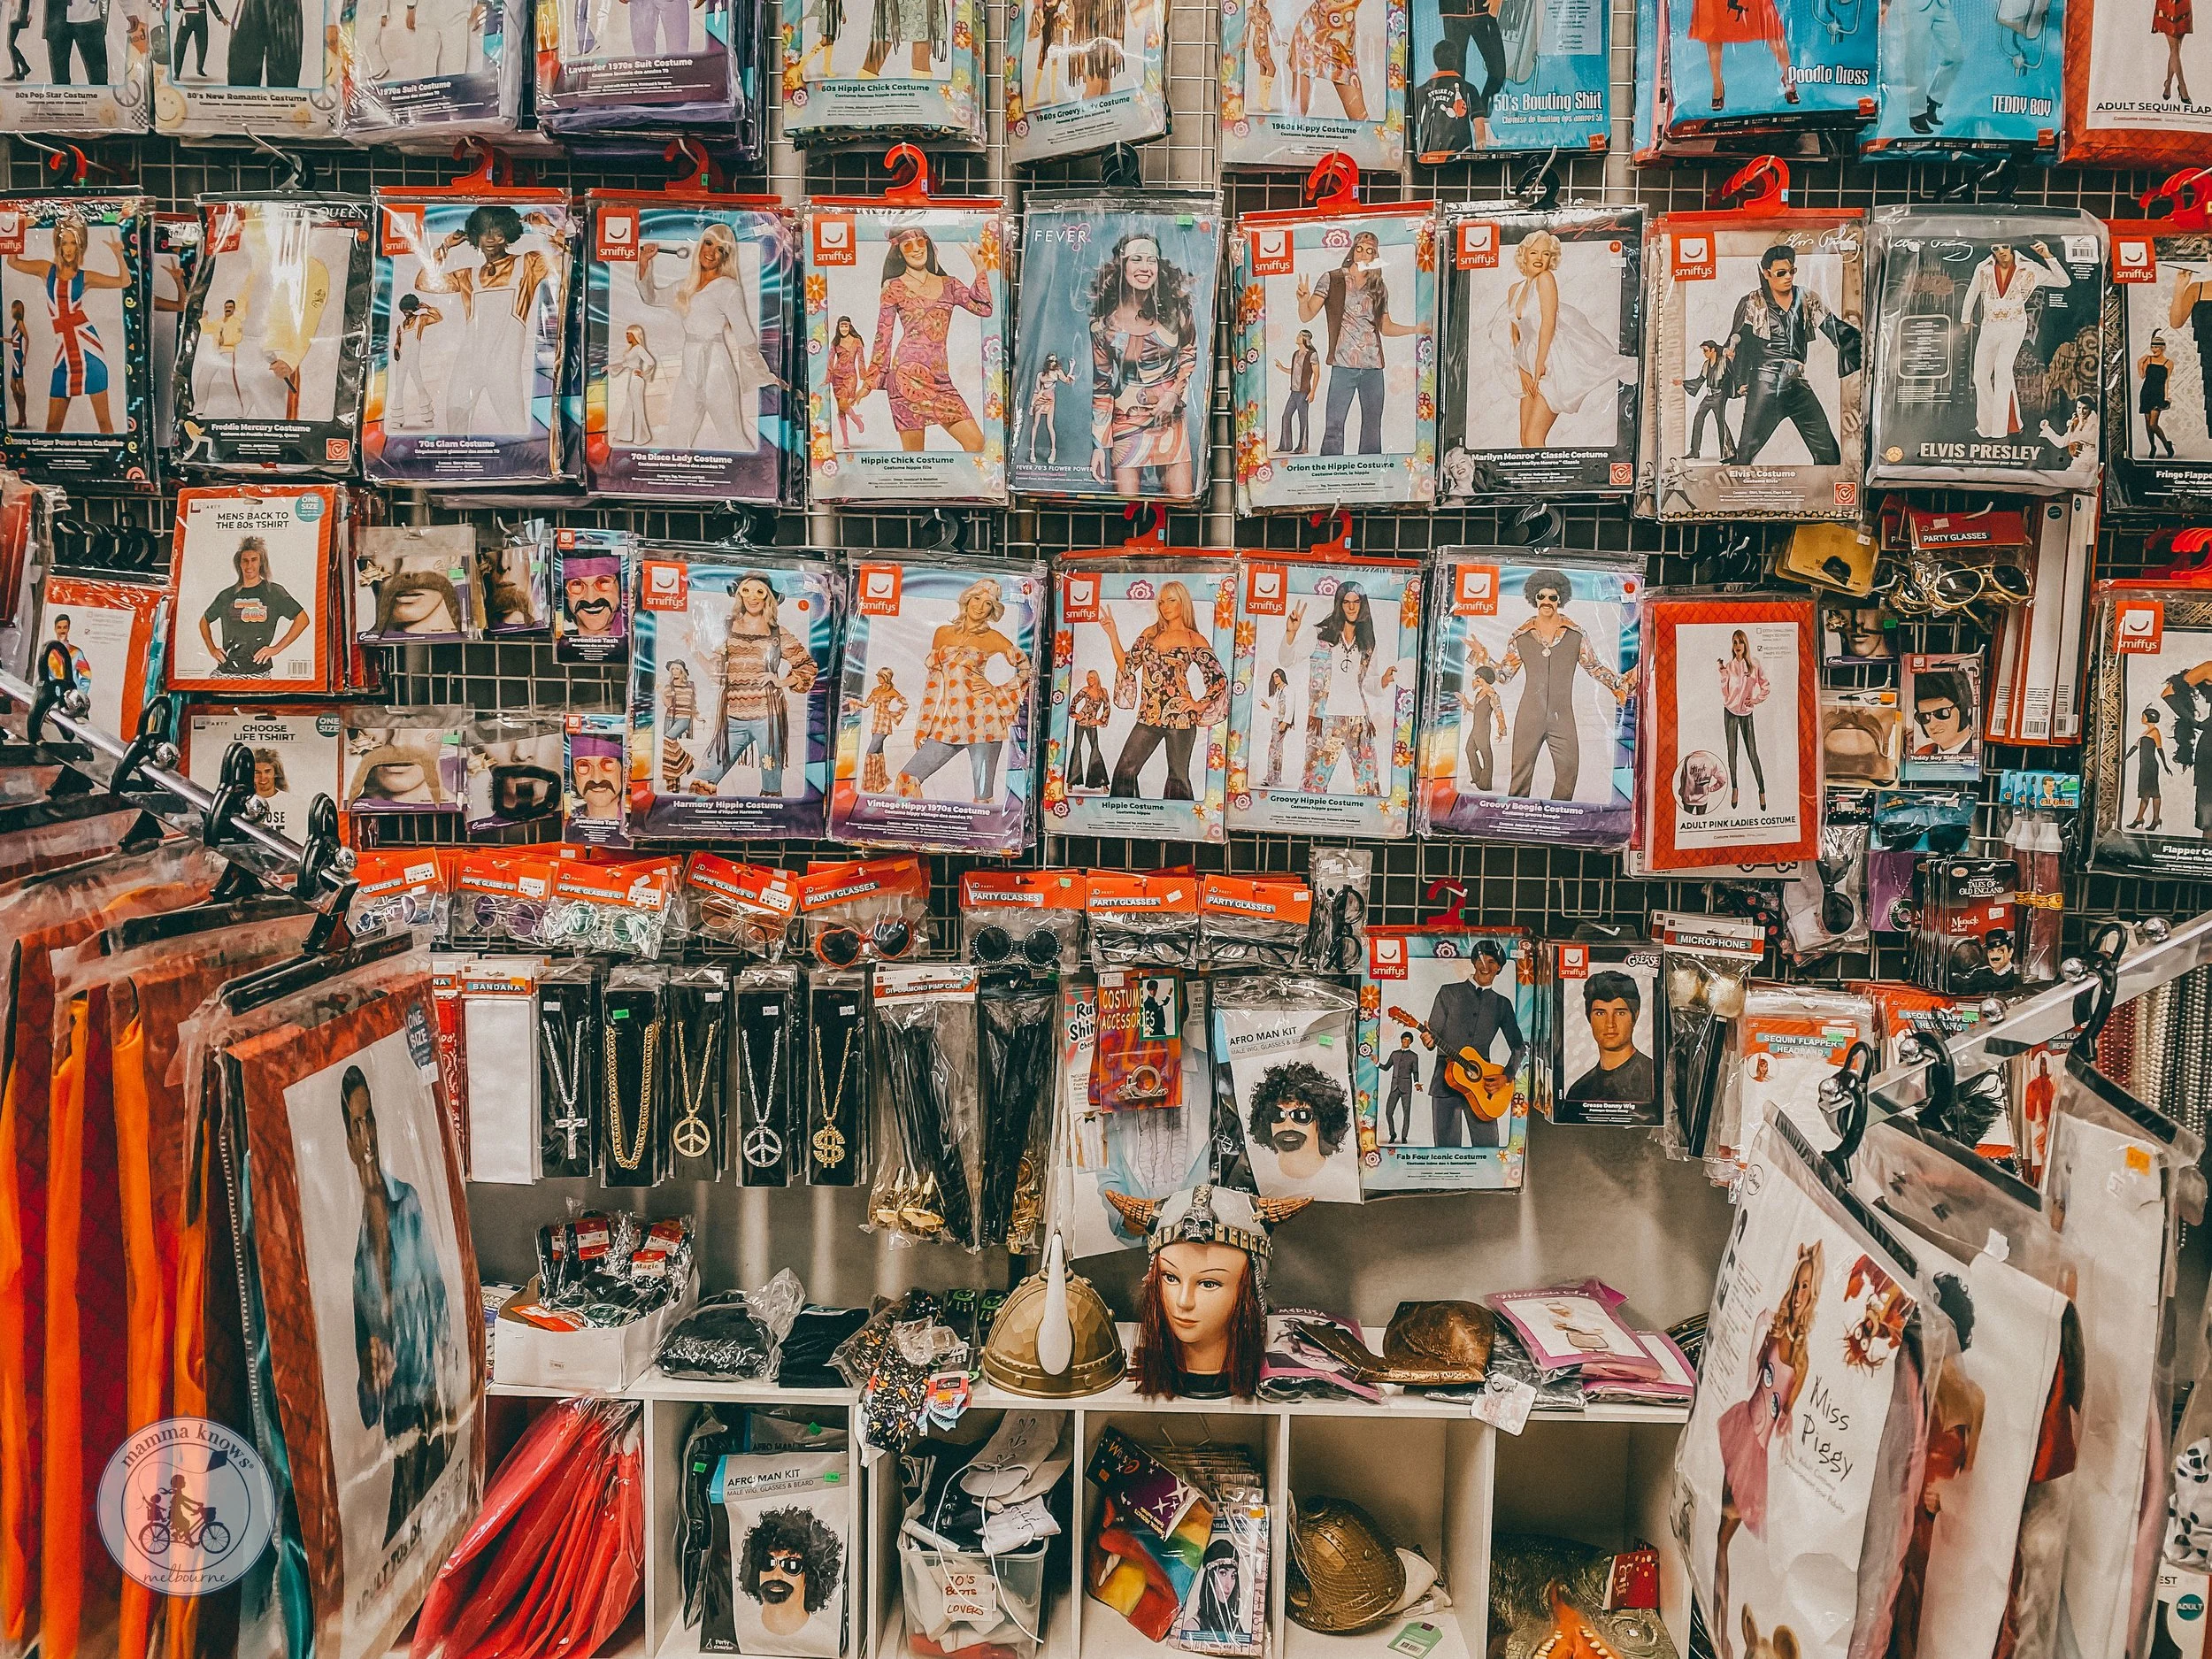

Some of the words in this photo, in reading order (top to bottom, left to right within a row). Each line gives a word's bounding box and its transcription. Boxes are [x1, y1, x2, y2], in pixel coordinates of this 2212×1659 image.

[568, 63, 606, 74] Lavender
[608, 61, 633, 72] 1970s
[634, 60, 652, 70] Suit
[654, 58, 693, 68] Costume
[1788, 65, 1832, 85] Poodle
[1835, 65, 1870, 86] Dress
[403, 84, 418, 93] Suit
[419, 81, 451, 92] Costume
[821, 84, 836, 93] 60s
[837, 84, 864, 95] Hippie
[866, 83, 890, 92] Chick
[892, 83, 930, 92] Costume
[29, 91, 44, 102] Pop
[223, 92, 266, 101] Romantic
[269, 93, 308, 102] Costume
[1494, 94, 1519, 112] 50's
[1523, 93, 1571, 112] Bowling
[1575, 91, 1602, 111] Shirt
[1992, 95, 2027, 114] TEDDY
[2030, 96, 2052, 117] BOY
[2096, 102, 2135, 111] ADULT
[2139, 102, 2181, 112] SEQUIN
[1034, 229, 1087, 243] FEVER
[600, 247, 636, 259] smiffys
[817, 251, 854, 265] smiffys
[1460, 253, 1496, 266] smiffys
[1255, 258, 1291, 272] smiffys
[1675, 266, 1715, 279] smiffys
[2116, 269, 2154, 282] smiffys
[241, 424, 273, 433] Mercury
[459, 440, 495, 449] Costume
[1920, 442, 1965, 458] ELVIS
[631, 452, 647, 461] 70s
[648, 453, 671, 462] Disco
[672, 454, 692, 465] Lady
[694, 455, 733, 464] Costume
[861, 456, 888, 466] Hippie
[890, 456, 913, 465] Chick
[916, 456, 955, 465] Costume
[1471, 452, 1502, 462] Marilyn
[1571, 450, 1609, 459] Costume
[1286, 463, 1310, 472] Orion
[1311, 462, 1325, 471] the
[1327, 461, 1355, 472] Hippie
[1756, 470, 1796, 479] Costume
[2156, 470, 2183, 481] Fringe
[218, 512, 244, 521] MENS
[257, 520, 289, 529] TSHIRT
[1923, 533, 1949, 542] PARTY
[1949, 532, 1987, 541] GLASSES
[646, 596, 685, 611] smiffys
[1248, 601, 1284, 614] smiffys
[1458, 601, 1495, 613] smiffys
[1065, 608, 1098, 620] smiffys
[242, 724, 287, 733] CHOOSE
[234, 733, 256, 741] LIFE
[258, 732, 296, 741] TSHIRT
[673, 800, 713, 810] Harmony
[715, 801, 743, 811] Hippie
[745, 801, 784, 810] Costume
[866, 799, 899, 810] Vintage
[901, 802, 926, 812] Hippy
[928, 803, 952, 812] 1970s
[953, 806, 990, 816] Costume
[1102, 802, 1127, 811] Hippie
[1129, 803, 1164, 811] Costume
[1270, 795, 1296, 805] Groovy
[1299, 796, 1327, 806] Hippie
[1328, 798, 1364, 807] Costume
[1479, 800, 1510, 811] Groovy
[1512, 803, 1543, 814] Boogie
[1544, 805, 1584, 816] Costume
[1680, 821, 1708, 830] ADULT
[1709, 819, 1729, 828] PINK
[1731, 818, 1759, 827] LADIES
[1760, 816, 1796, 826] COSTUME
[364, 881, 393, 894] GLASSES
[808, 891, 835, 904] PARTY
[837, 882, 876, 898] GLASSES
[1974, 887, 2004, 895] ENGLAND
[972, 892, 999, 902] PARTY
[1000, 893, 1039, 902] GLASSES
[1093, 898, 1118, 907] PARTY
[1119, 898, 1157, 907] GLASSES
[1208, 896, 1234, 907] PARTY
[1235, 900, 1271, 912] GLASSES
[1680, 935, 1747, 949] MICROPHONE
[1626, 953, 1661, 969] GREASE
[1372, 965, 1407, 978] smiffys
[1561, 969, 1586, 979] smiffys
[472, 983, 521, 992] BANDANA
[1102, 987, 1144, 1010] COSTUME
[1102, 1010, 1156, 1031] ACCESSORIES
[1229, 1033, 1254, 1046] AFRO
[1256, 1029, 1279, 1042] MAN
[1282, 1026, 1298, 1038] KIT
[1764, 1035, 1796, 1045] SEQUIN
[1798, 1036, 1838, 1048] FLAPPER
[1606, 1102, 1623, 1111] Danny
[1810, 1375, 1850, 1432] Miss
[1803, 1414, 1853, 1479] Piggy
[727, 1475, 755, 1487] AFRO
[757, 1471, 782, 1484] MAN
[785, 1469, 801, 1479] KIT
